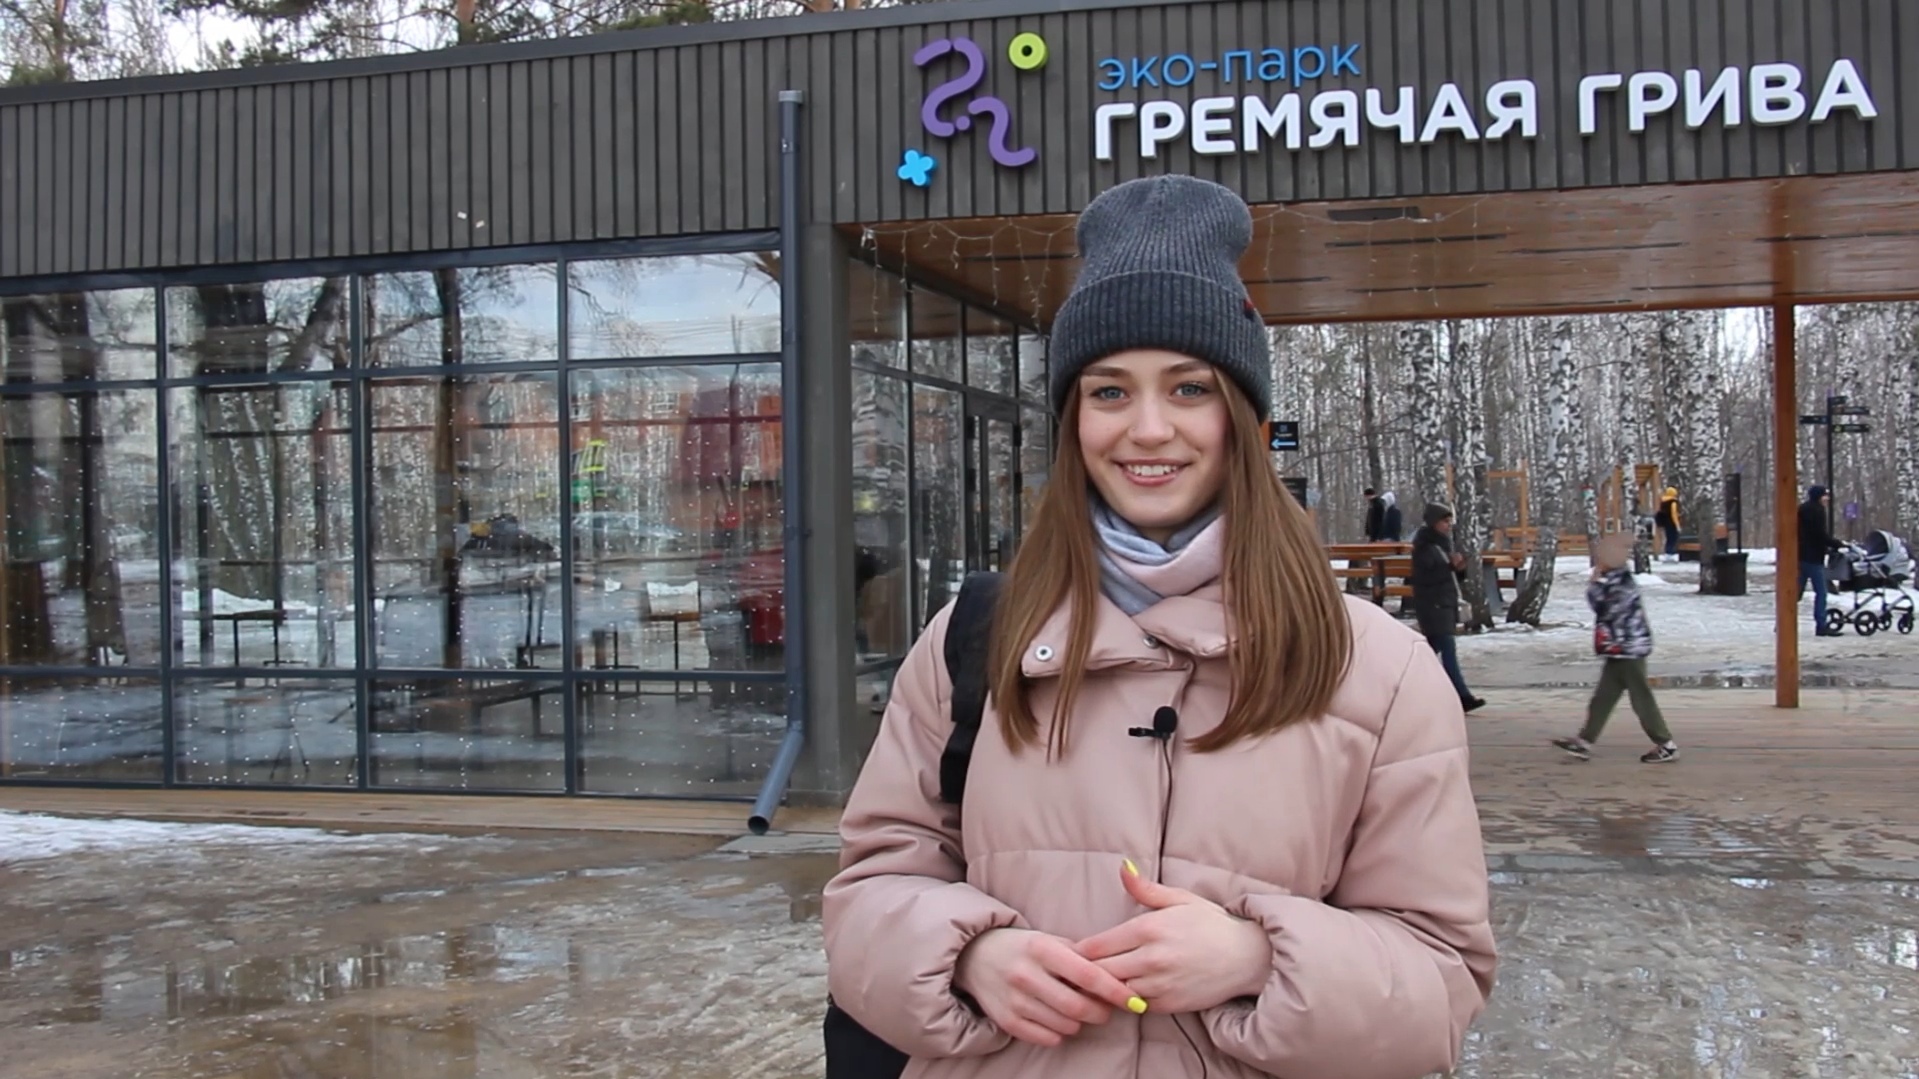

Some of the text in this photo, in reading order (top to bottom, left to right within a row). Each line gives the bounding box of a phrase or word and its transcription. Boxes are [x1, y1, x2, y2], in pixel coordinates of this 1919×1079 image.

[1097, 42, 1361, 92] эко-парк
[1094, 58, 1878, 161] ГРЕМЯЧАЯ ГРИВА
